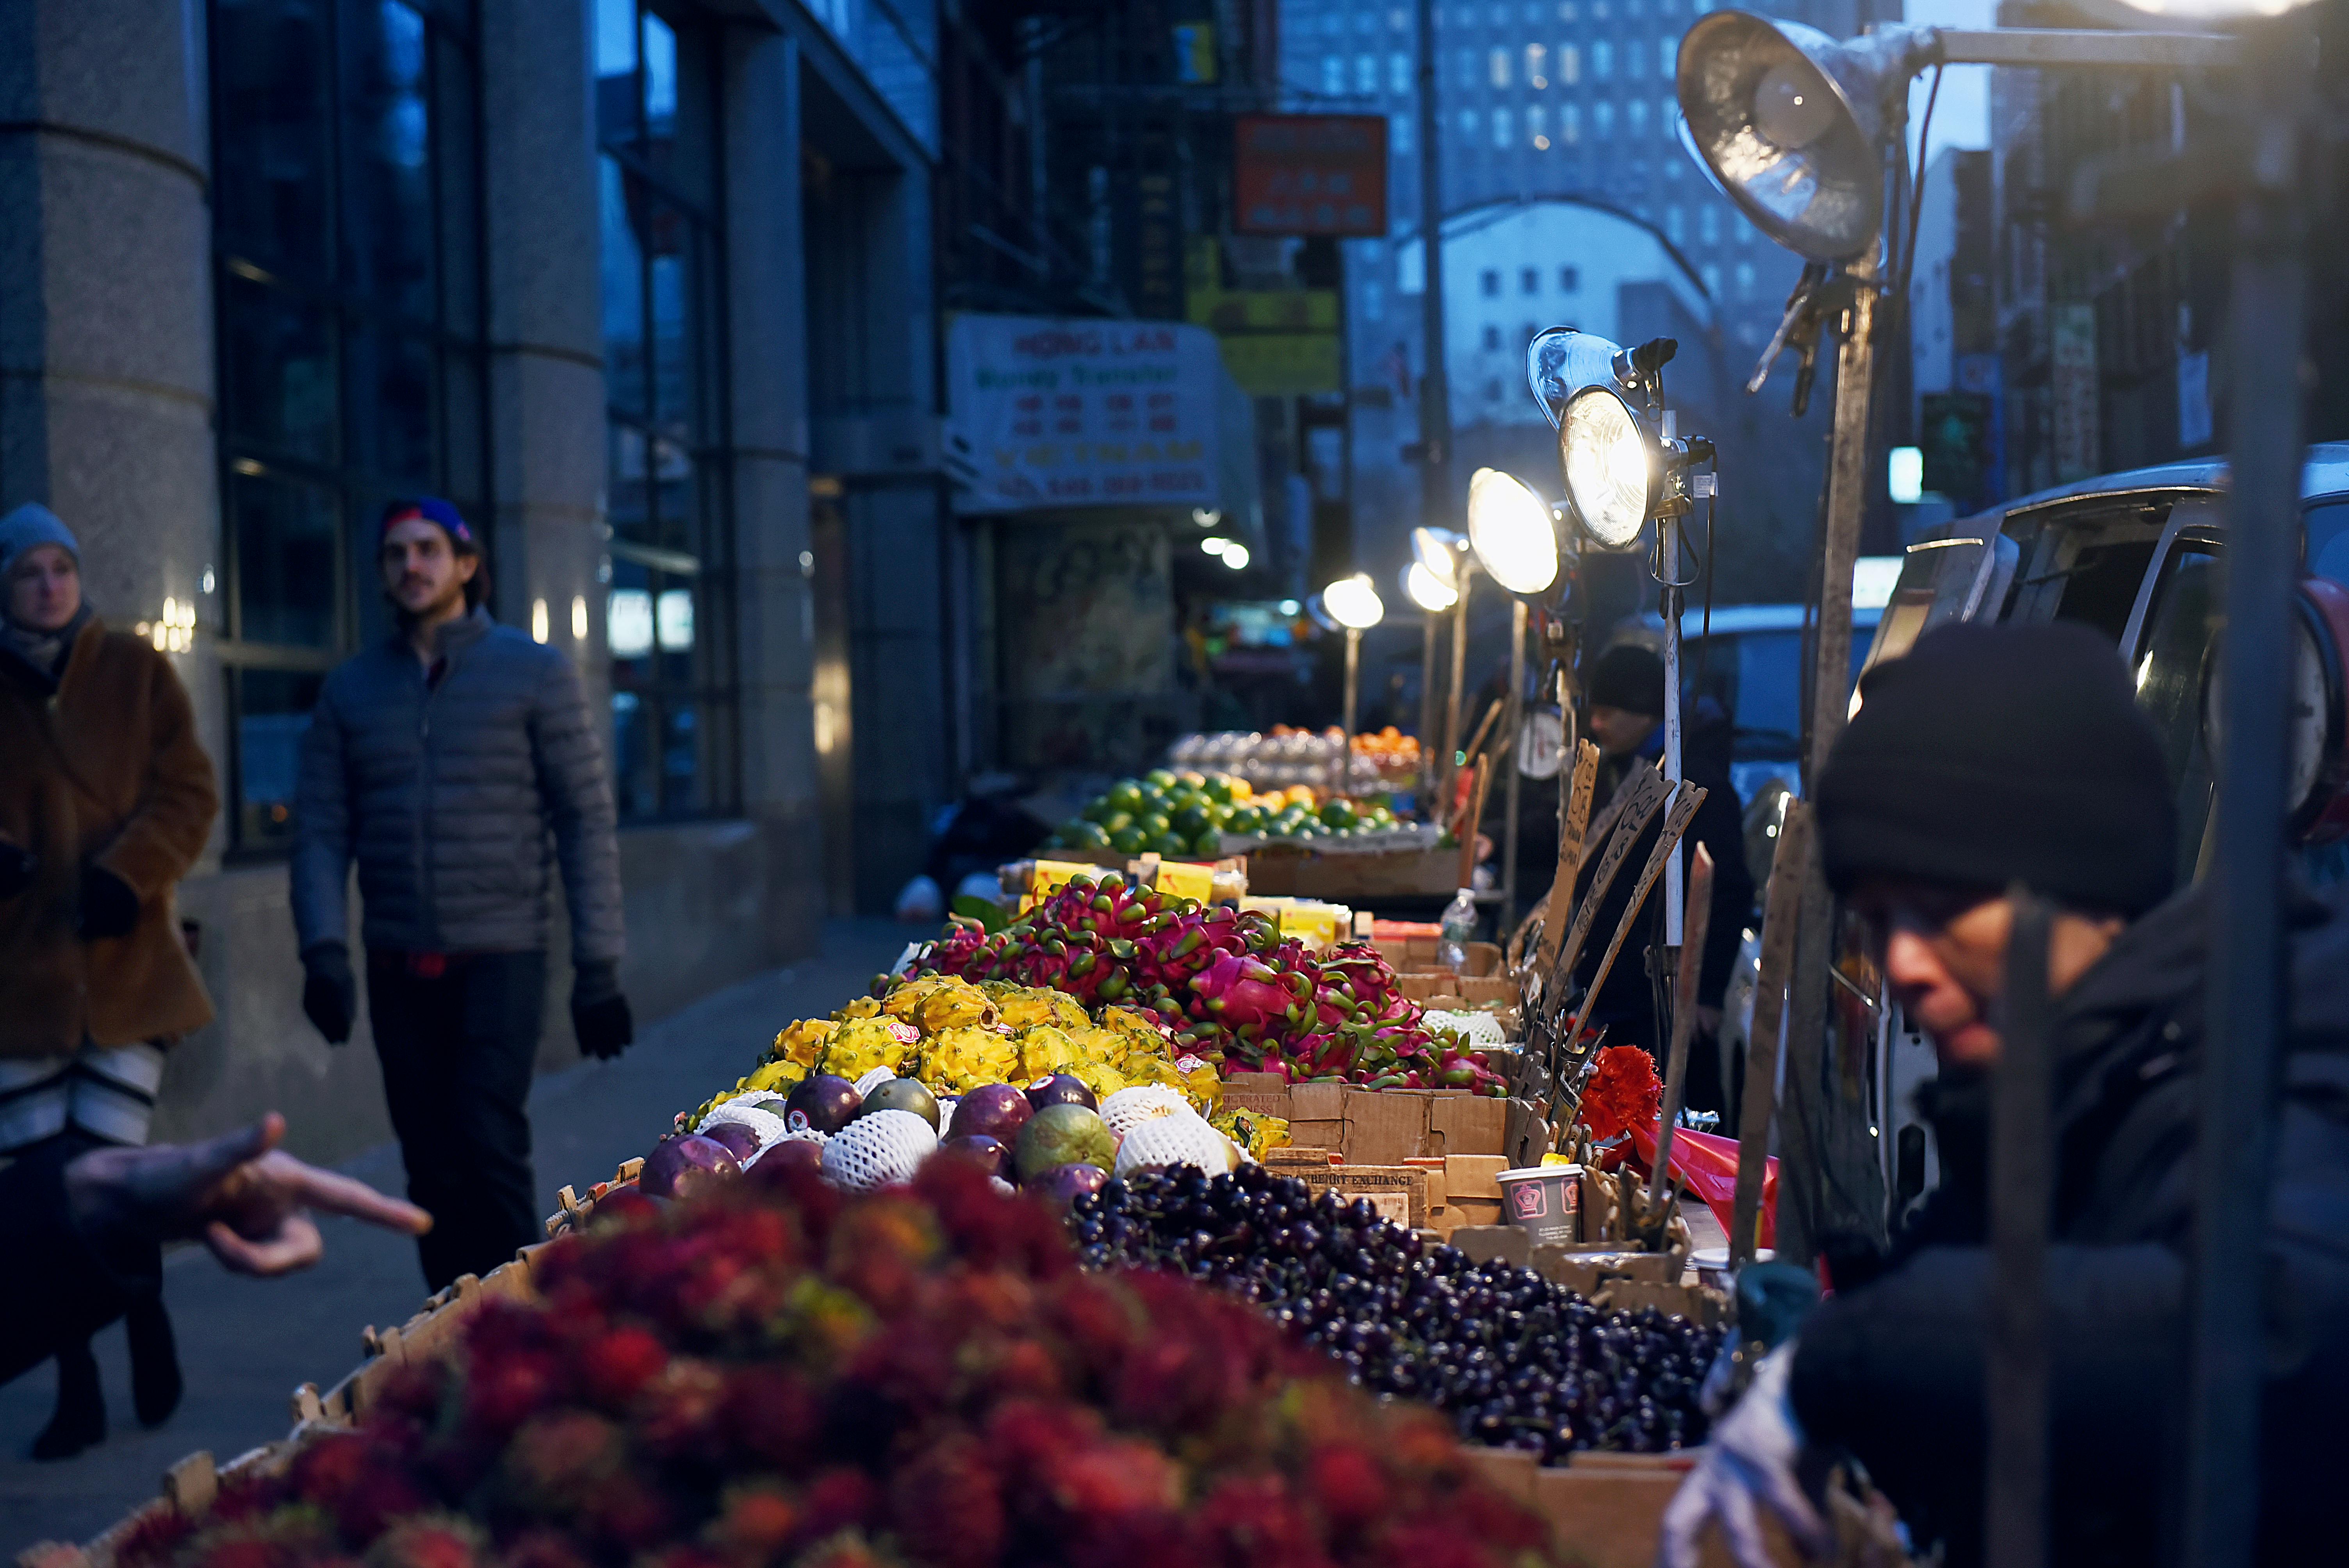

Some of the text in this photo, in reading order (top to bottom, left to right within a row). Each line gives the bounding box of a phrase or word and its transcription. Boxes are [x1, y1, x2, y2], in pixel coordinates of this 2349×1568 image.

[1223, 1095, 1280, 1103] RIGERATED
[1273, 1174, 1413, 1185] BERRY EXCHANGE
